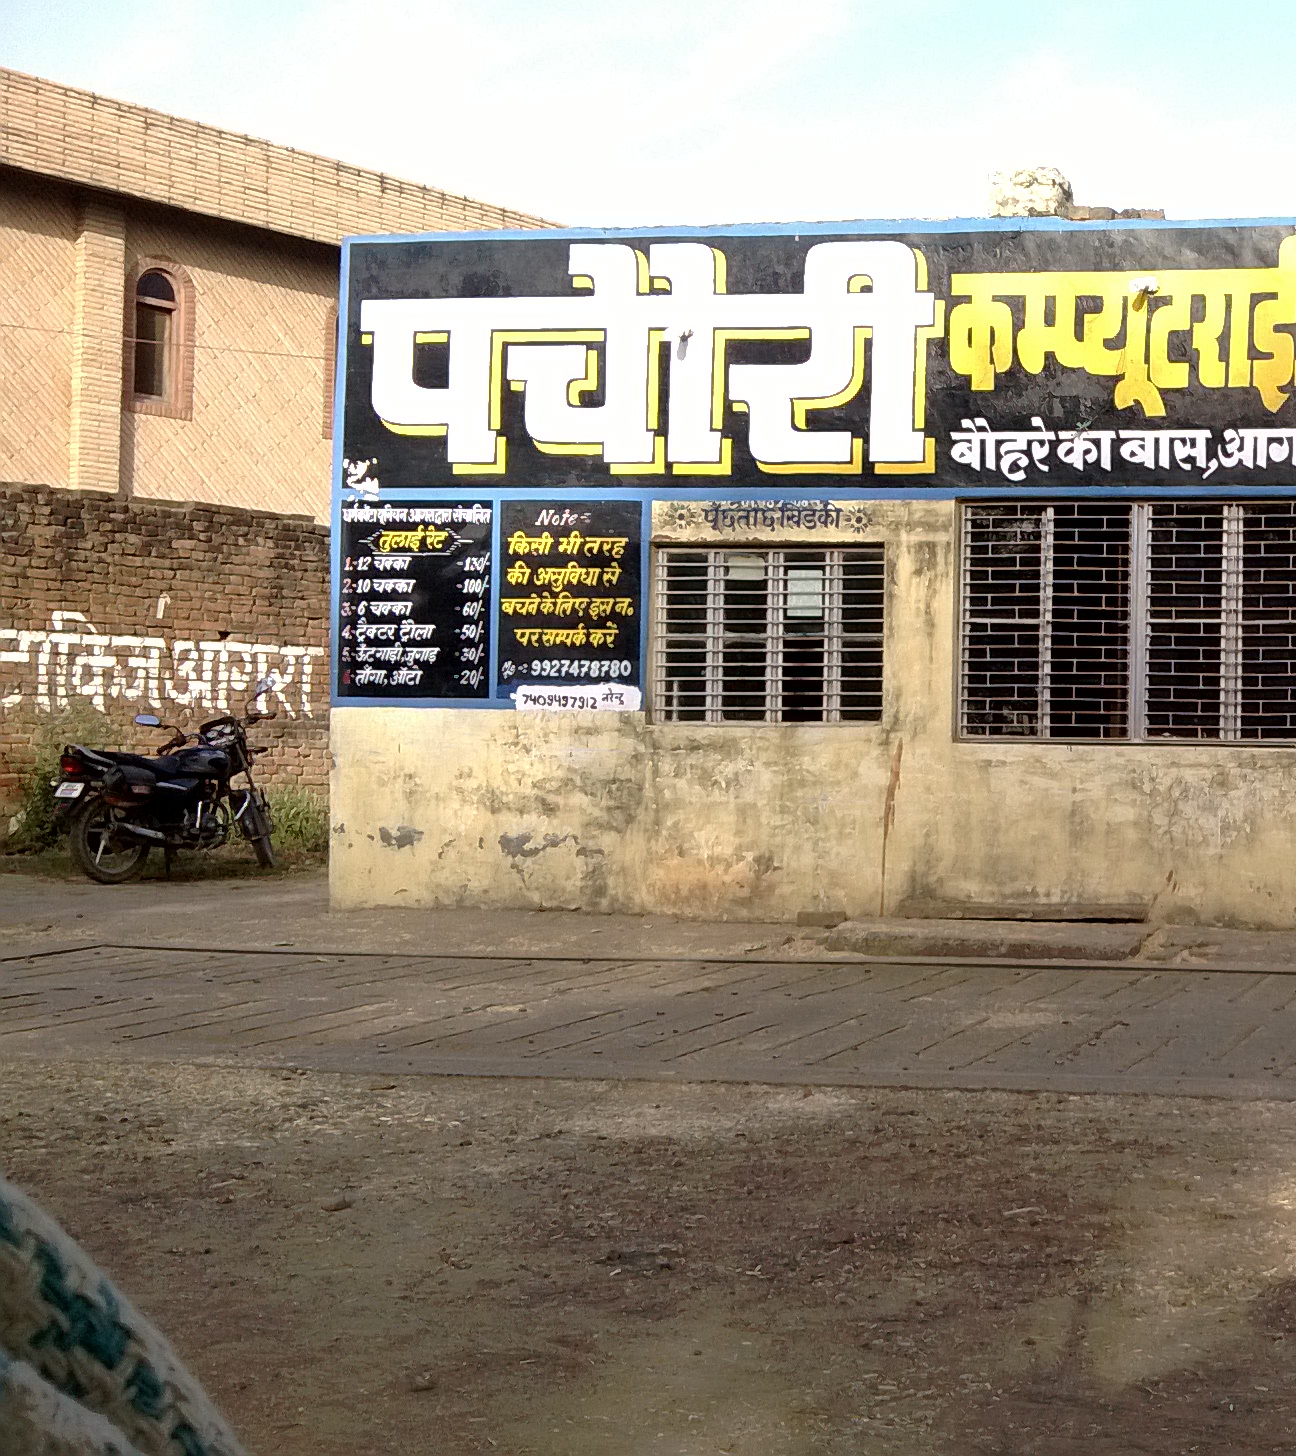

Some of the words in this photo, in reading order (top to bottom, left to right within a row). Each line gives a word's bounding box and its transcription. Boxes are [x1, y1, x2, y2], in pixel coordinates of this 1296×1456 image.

[360, 241, 945, 475] पचौरी
[950, 416, 1056, 482] बौहरे
[1056, 429, 1117, 472] का
[507, 531, 554, 555] किसी
[558, 531, 584, 555] भी
[583, 537, 629, 559] तरह
[507, 561, 531, 585] की
[534, 561, 601, 592] असुविधा
[602, 562, 622, 587] से
[555, 591, 590, 618] लिए
[590, 597, 615, 621] इस
[514, 628, 542, 648] पर
[542, 623, 587, 647] सम्पर्क
[530, 660, 632, 678] 9927478780
